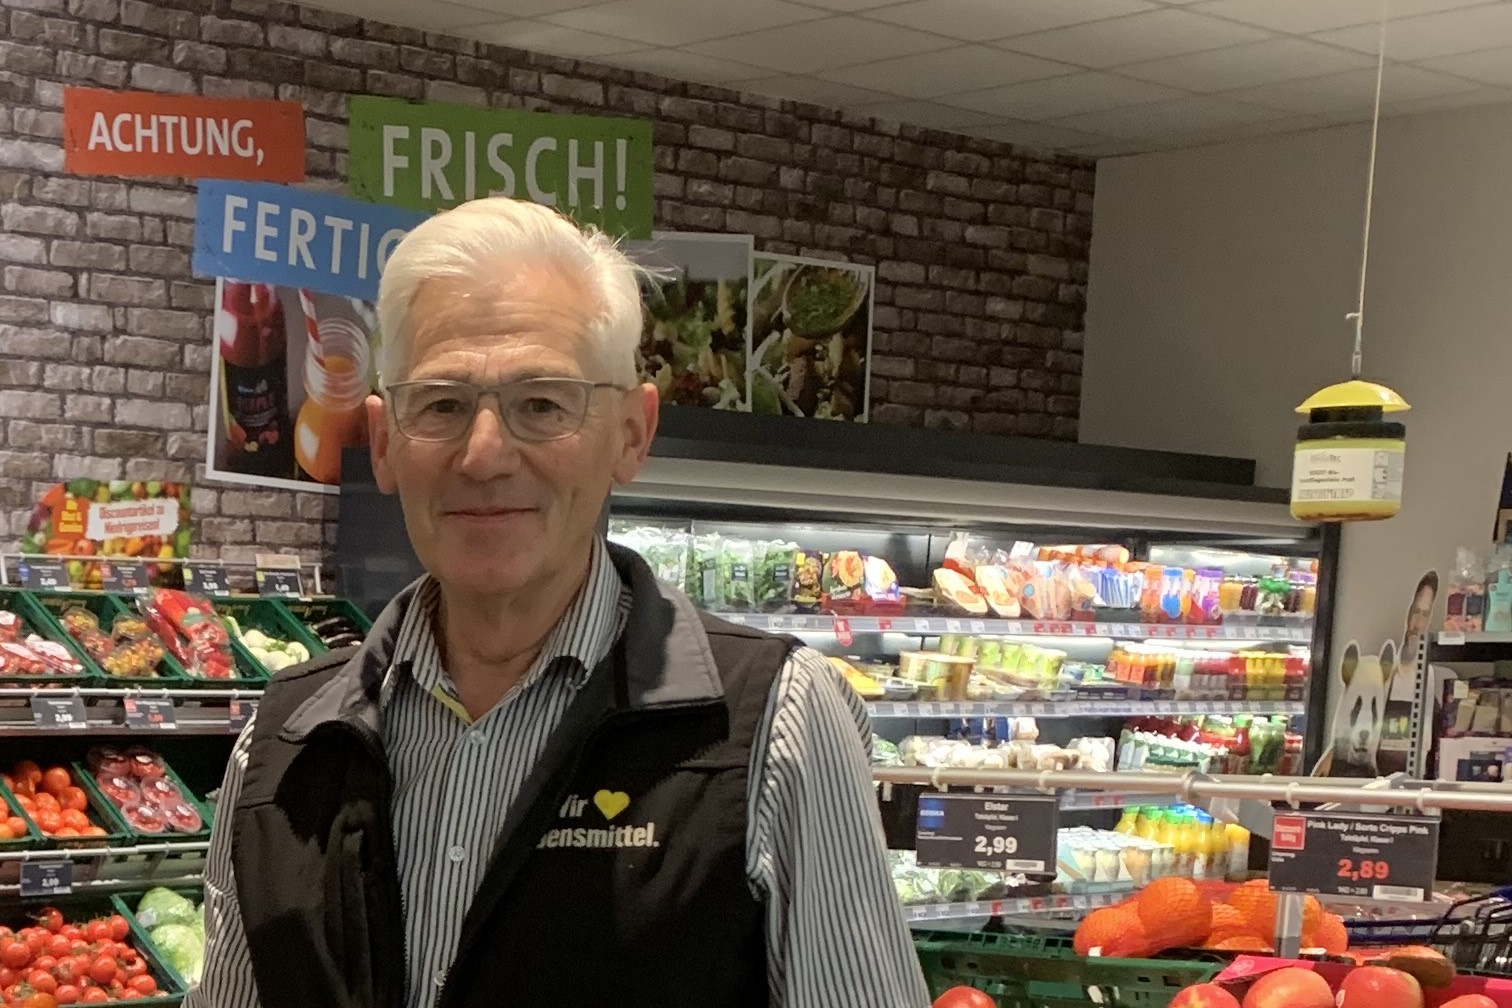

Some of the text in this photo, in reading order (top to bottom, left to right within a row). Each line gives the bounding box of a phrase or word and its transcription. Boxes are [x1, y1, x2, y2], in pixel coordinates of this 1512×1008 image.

[88, 110, 265, 166] ACHTUNG,
[382, 123, 629, 211] FRISCH!
[984, 801, 1009, 811] Elstar
[1307, 820, 1326, 829] Pink
[1327, 821, 1349, 832] Lady
[1355, 823, 1378, 832] Sorte
[1379, 824, 1407, 836] Cripps
[1409, 825, 1429, 835] Pink
[974, 835, 1018, 856] 2,99
[1337, 858, 1390, 881] 2,89
